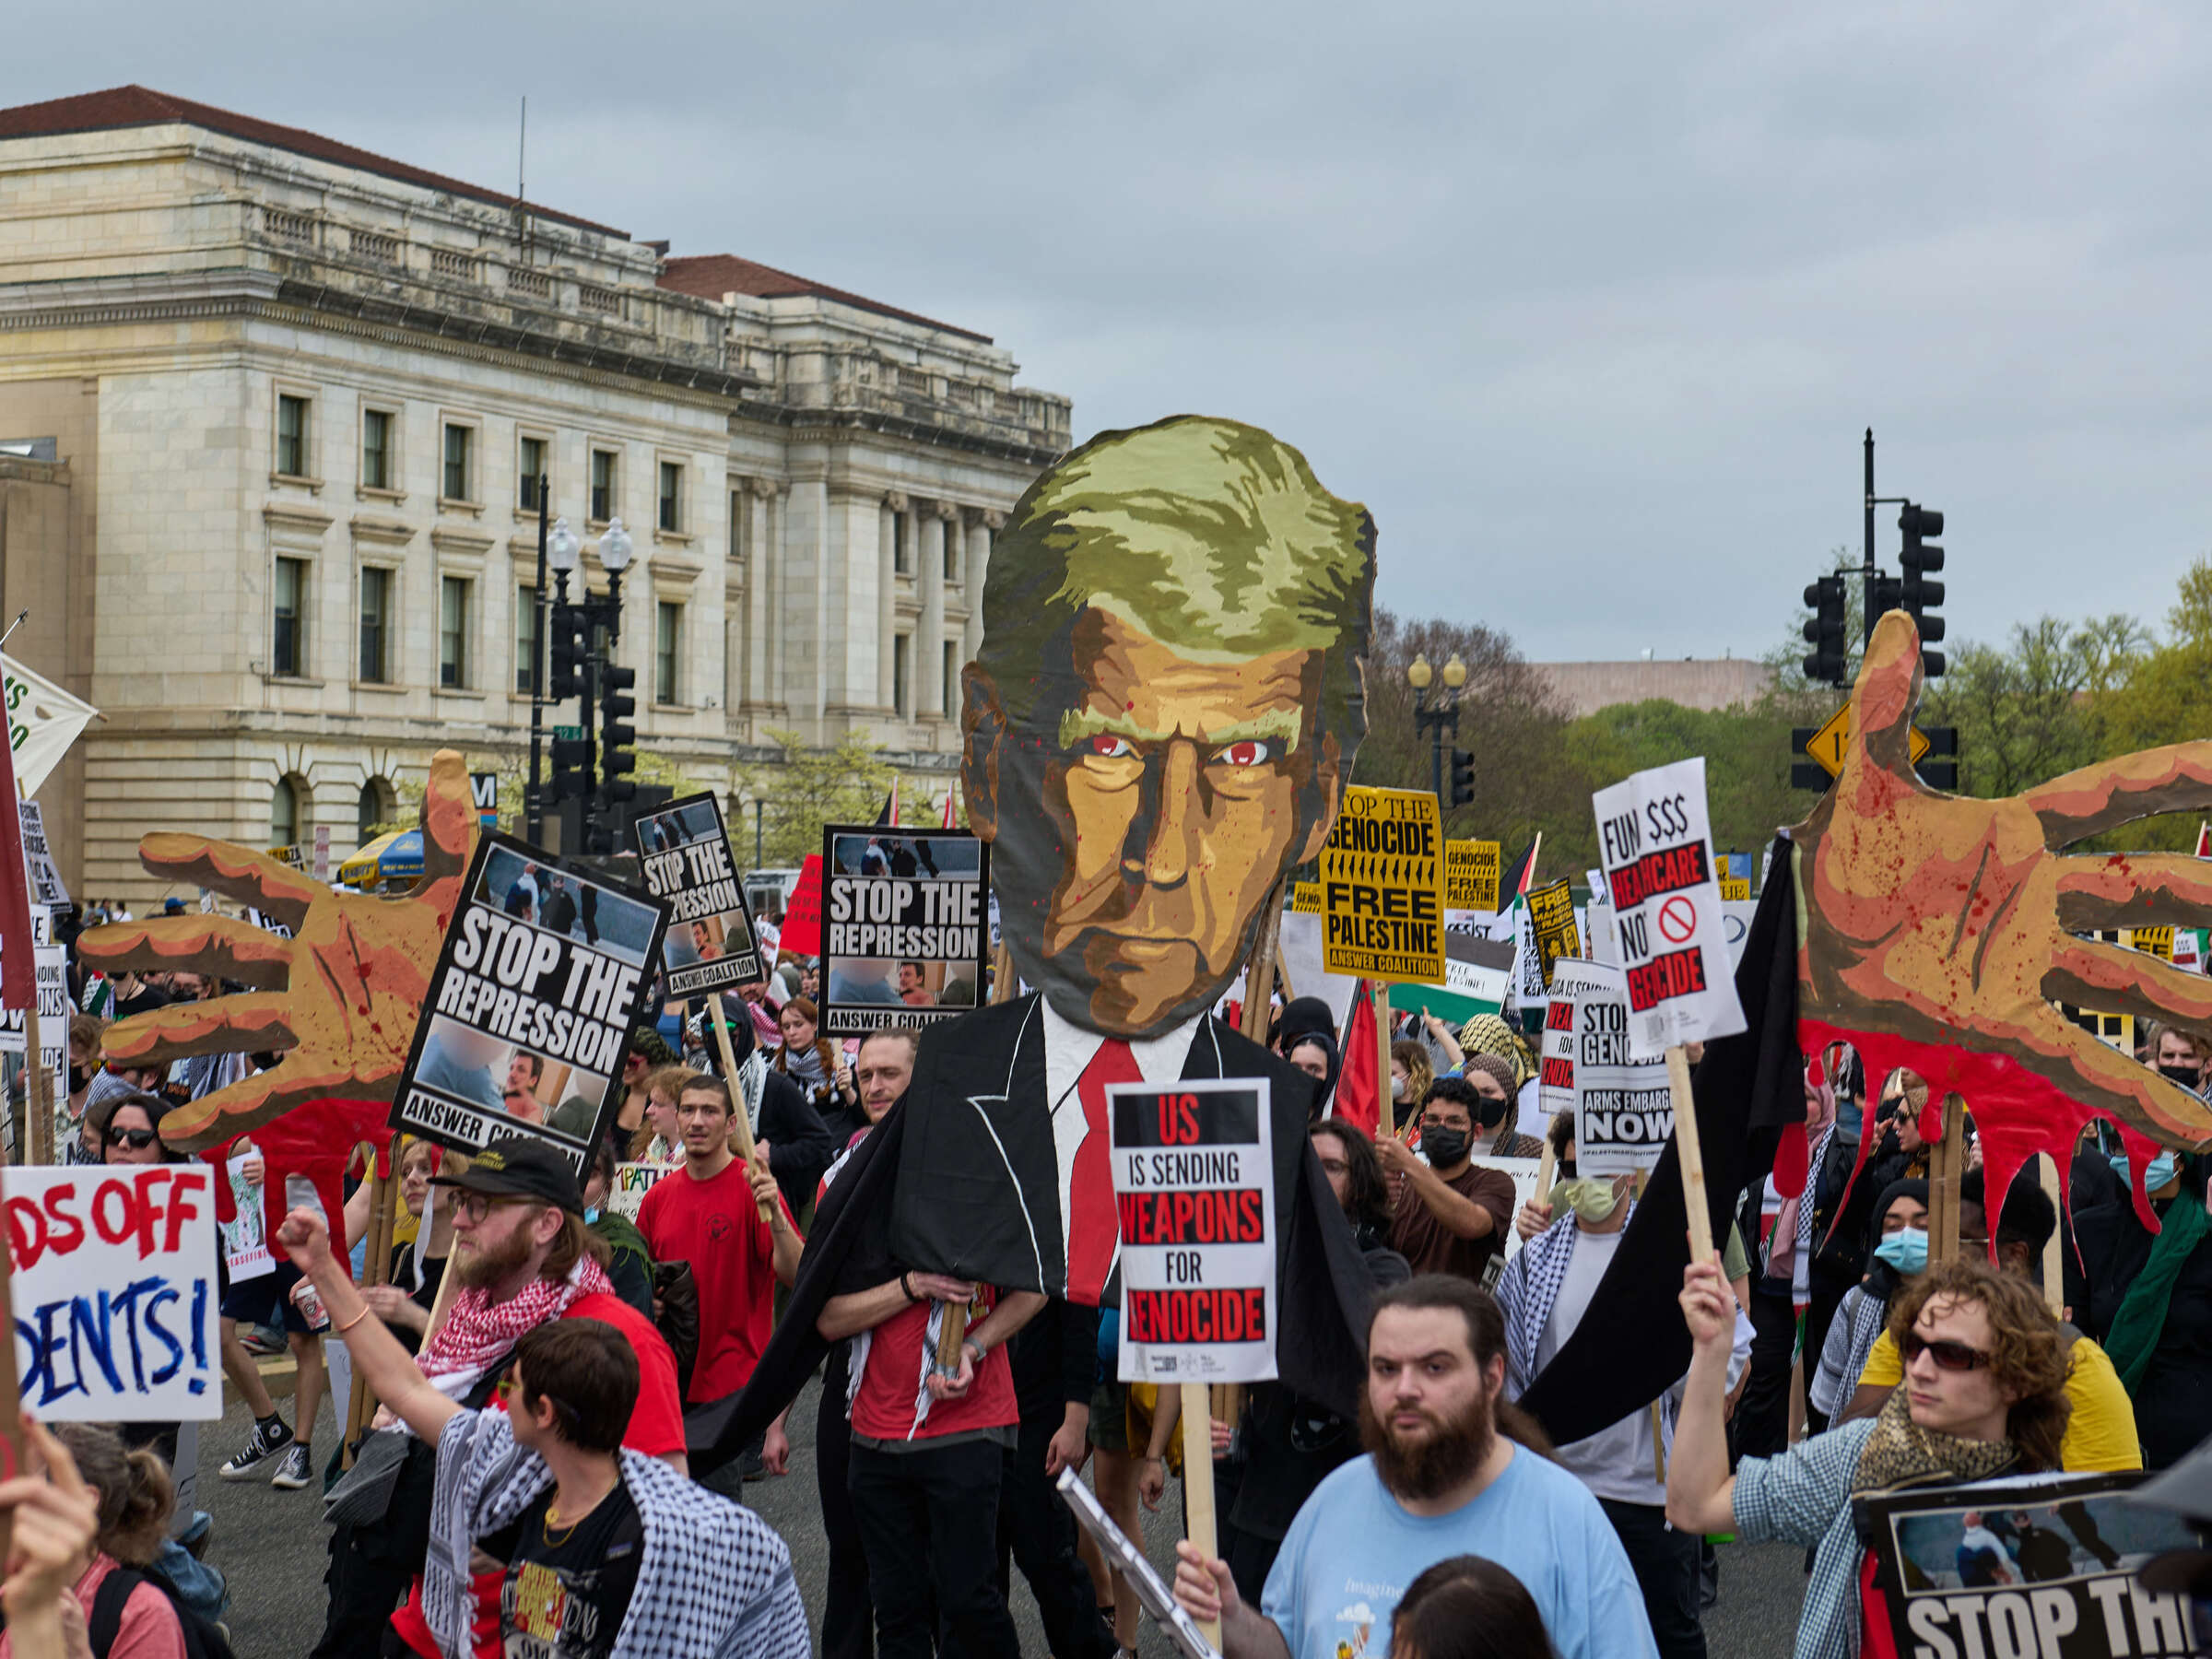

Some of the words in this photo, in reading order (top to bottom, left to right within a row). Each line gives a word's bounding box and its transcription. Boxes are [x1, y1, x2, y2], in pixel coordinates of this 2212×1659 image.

[471, 776, 495, 806] M
[1384, 797, 1433, 821] THE
[1327, 816, 1435, 857] GENOCIDE
[1647, 793, 1688, 846] $$$
[644, 850, 685, 898] STOP
[686, 840, 733, 886] THE
[1448, 852, 1497, 866] GENOCIDE
[830, 878, 913, 924] STOP
[921, 882, 980, 925] THE
[1327, 882, 1437, 920] FREE
[1447, 889, 1496, 902] PALESTINE
[1448, 877, 1497, 890] FREE
[1530, 884, 1571, 914] FREE
[830, 923, 979, 959] REPRESSION
[1328, 914, 1438, 954] PALESTINE
[1618, 911, 1648, 963] NO
[453, 906, 562, 995] STOP
[560, 952, 642, 1030] THE
[702, 957, 757, 984] COALITION
[1331, 948, 1375, 968] ANSWER
[1378, 956, 1440, 977] COALITION
[436, 965, 624, 1075] REPRESSION
[830, 1010, 893, 1030] ANSWER
[406, 1095, 483, 1143] ANSWER
[1585, 1091, 1620, 1112] ARMS
[1623, 1089, 1673, 1112] EMBARG
[1159, 1093, 1199, 1146] US
[1585, 1112, 1674, 1142] NOW
[1130, 1155, 1146, 1186] IS
[1152, 1152, 1240, 1185] SENDING
[91, 1168, 206, 1261] OFF
[1118, 1189, 1262, 1244] WEAPONS
[1166, 1252, 1202, 1284] FOR
[1907, 1587, 2078, 1659] STOP
